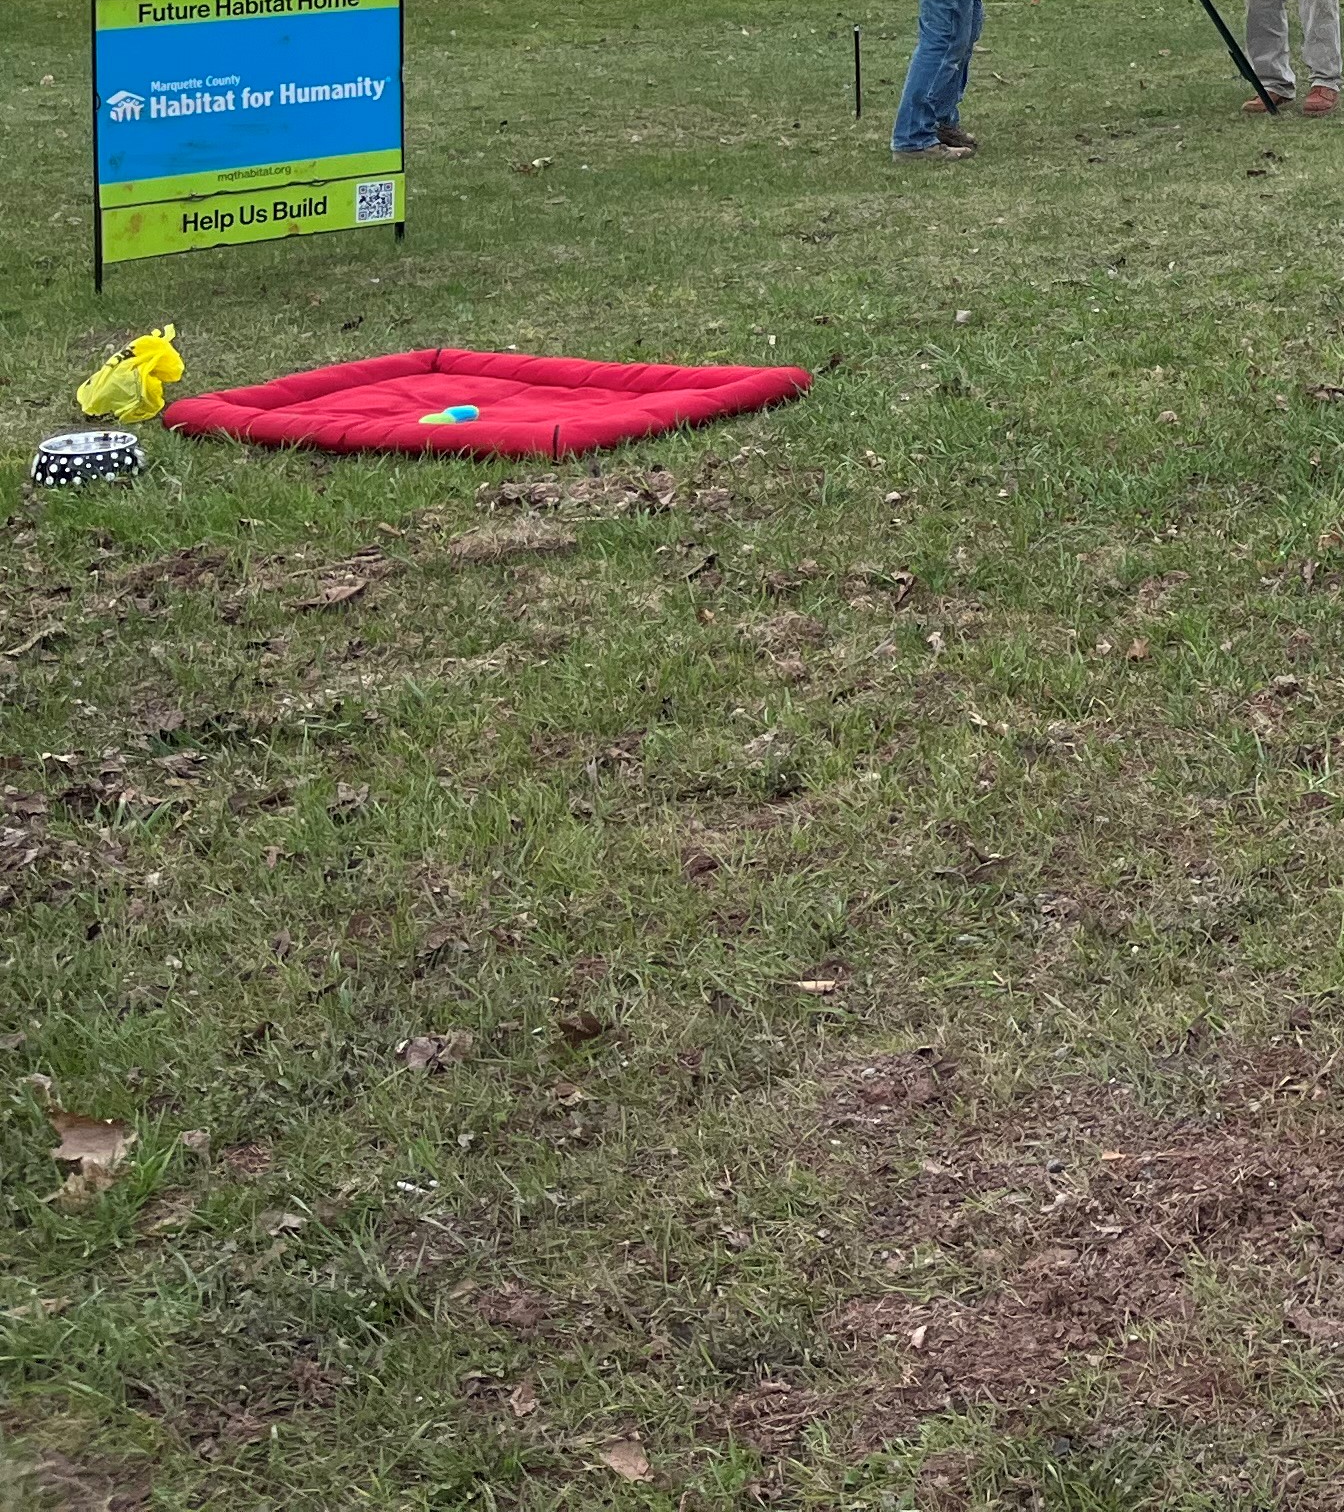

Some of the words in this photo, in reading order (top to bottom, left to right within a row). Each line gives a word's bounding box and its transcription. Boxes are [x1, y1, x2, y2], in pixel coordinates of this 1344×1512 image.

[138, 3, 211, 23] Future
[151, 77, 203, 93] Marquette
[206, 74, 241, 87] County
[150, 90, 235, 119] Habitat
[241, 87, 274, 109] for
[279, 75, 385, 105] Humanity
[217, 165, 292, 182] mqthabitat.org
[182, 209, 235, 233] Help
[239, 204, 268, 225] Us
[272, 196, 328, 221] Build
